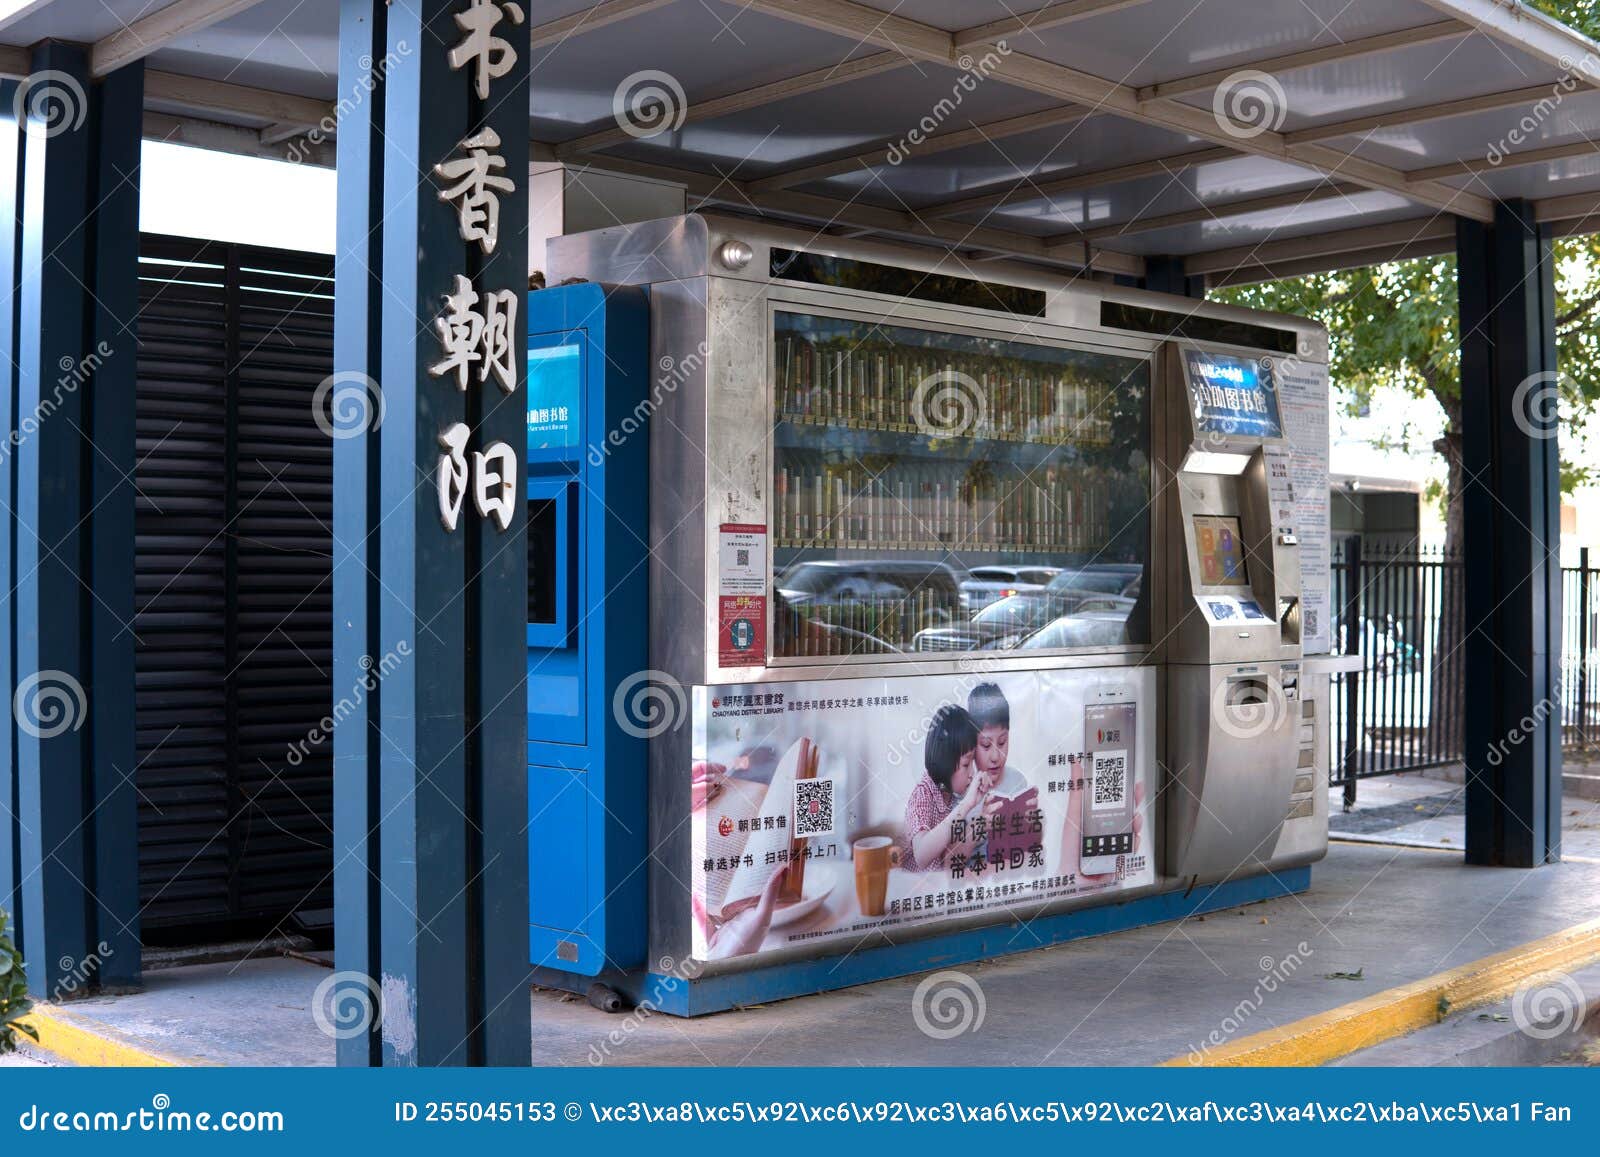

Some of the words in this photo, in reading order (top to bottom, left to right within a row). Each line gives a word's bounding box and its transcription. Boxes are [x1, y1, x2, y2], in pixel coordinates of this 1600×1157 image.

[430, 0, 524, 534] 书香朝阳
[527, 406, 568, 424] 助图书馆
[712, 709, 740, 718] CHAOYANG
[741, 708, 762, 717] DISTRICT
[763, 706, 784, 715] LIBRARY
[738, 815, 787, 833] 朝图预借
[950, 809, 1044, 844] 阅读伴生活
[704, 853, 754, 872] 精选好书
[950, 844, 1044, 879] 带本书回家
